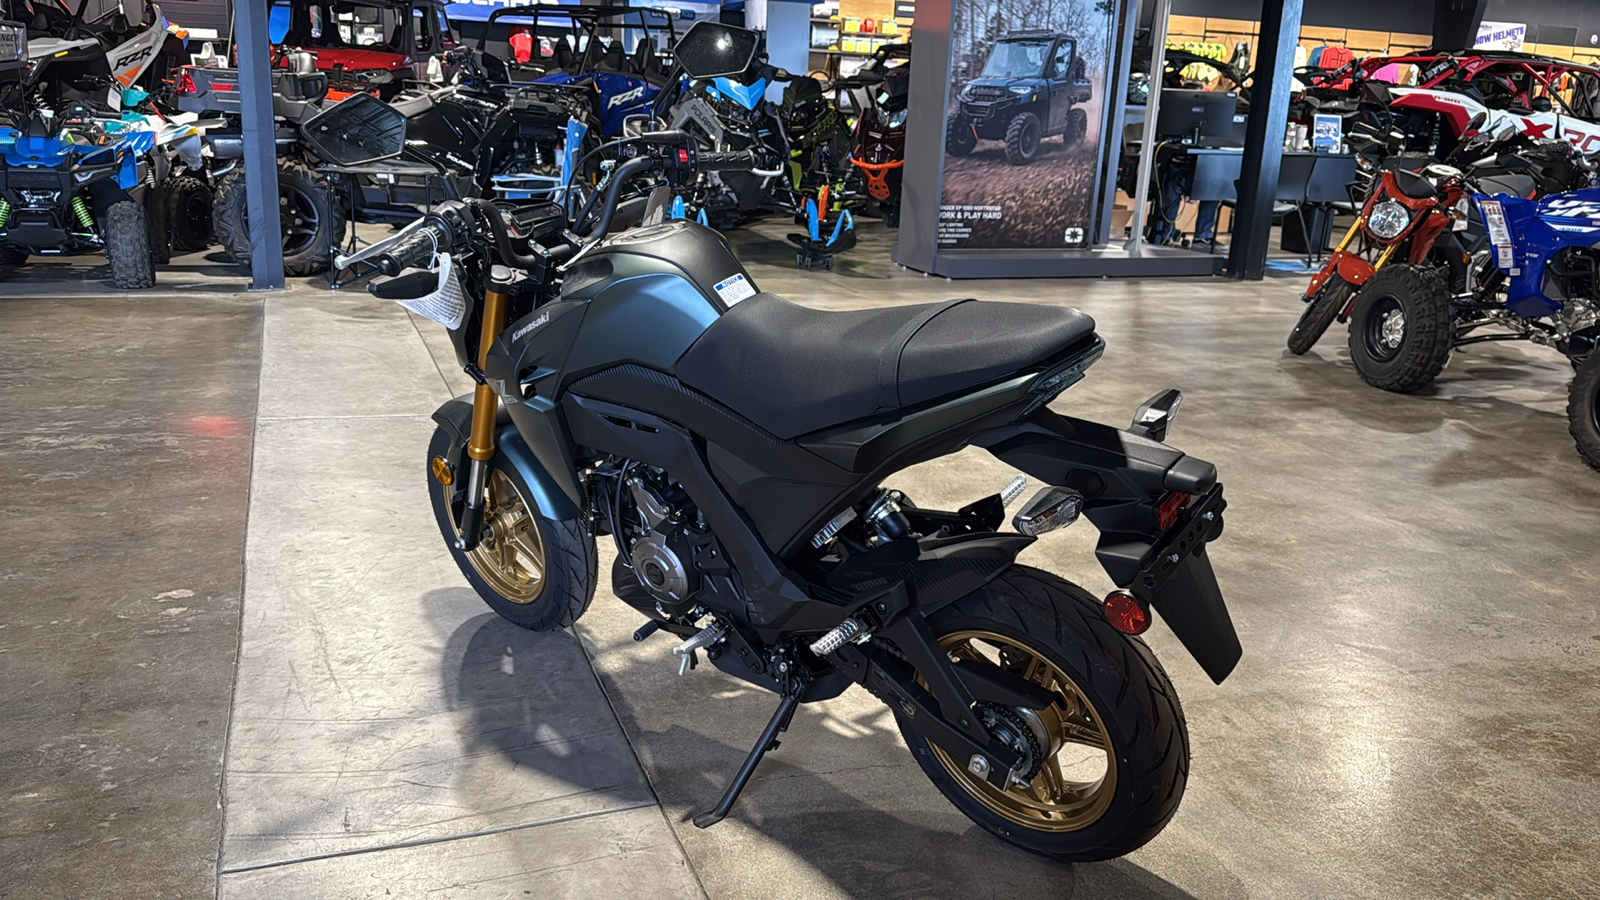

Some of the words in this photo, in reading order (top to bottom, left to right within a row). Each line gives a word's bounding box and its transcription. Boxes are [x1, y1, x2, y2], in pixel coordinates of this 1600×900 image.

[1493, 26, 1524, 42] HELMETS
[113, 46, 153, 71] RZR
[607, 86, 645, 110] RZR
[691, 104, 717, 134] POLARIS
[446, 152, 474, 170] POLARIS
[512, 311, 550, 344] Kawasaki
